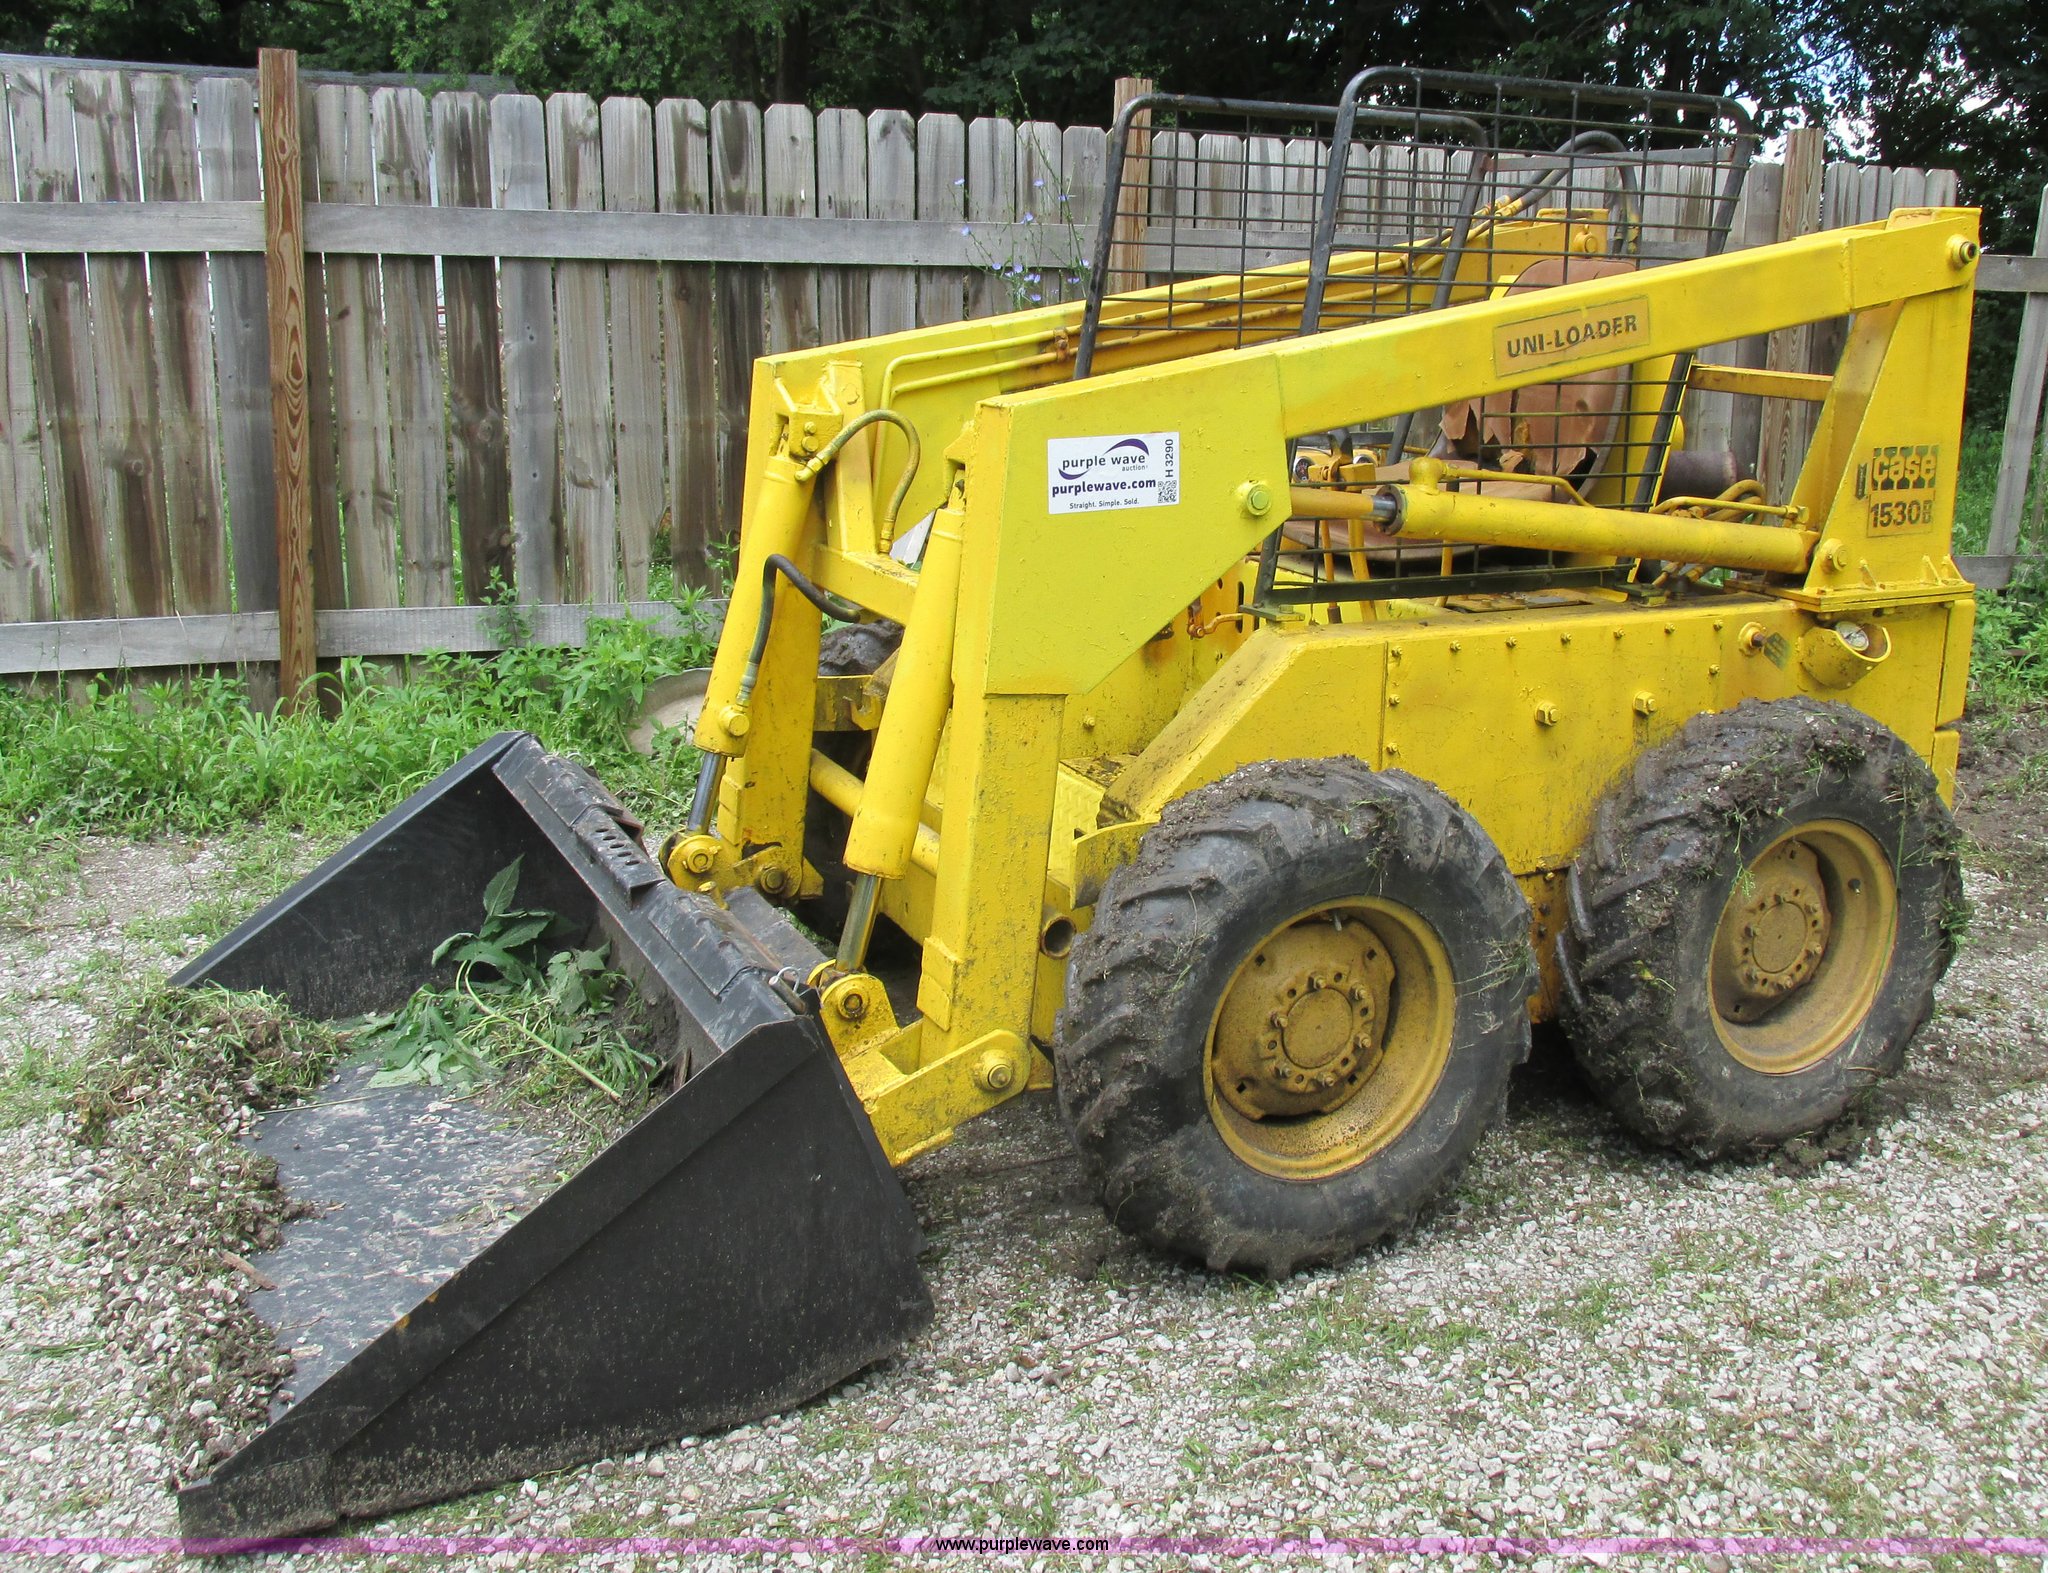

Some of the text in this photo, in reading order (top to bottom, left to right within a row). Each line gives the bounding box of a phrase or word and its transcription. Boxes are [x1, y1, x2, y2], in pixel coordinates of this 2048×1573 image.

[1507, 315, 1637, 358] UNI-LOADER
[1062, 454, 1146, 470] purple wave
[1165, 438, 1174, 478] H 3290
[1052, 479, 1156, 498] purplewave.com
[1069, 498, 1140, 510] Straight. Simple. Sold.
